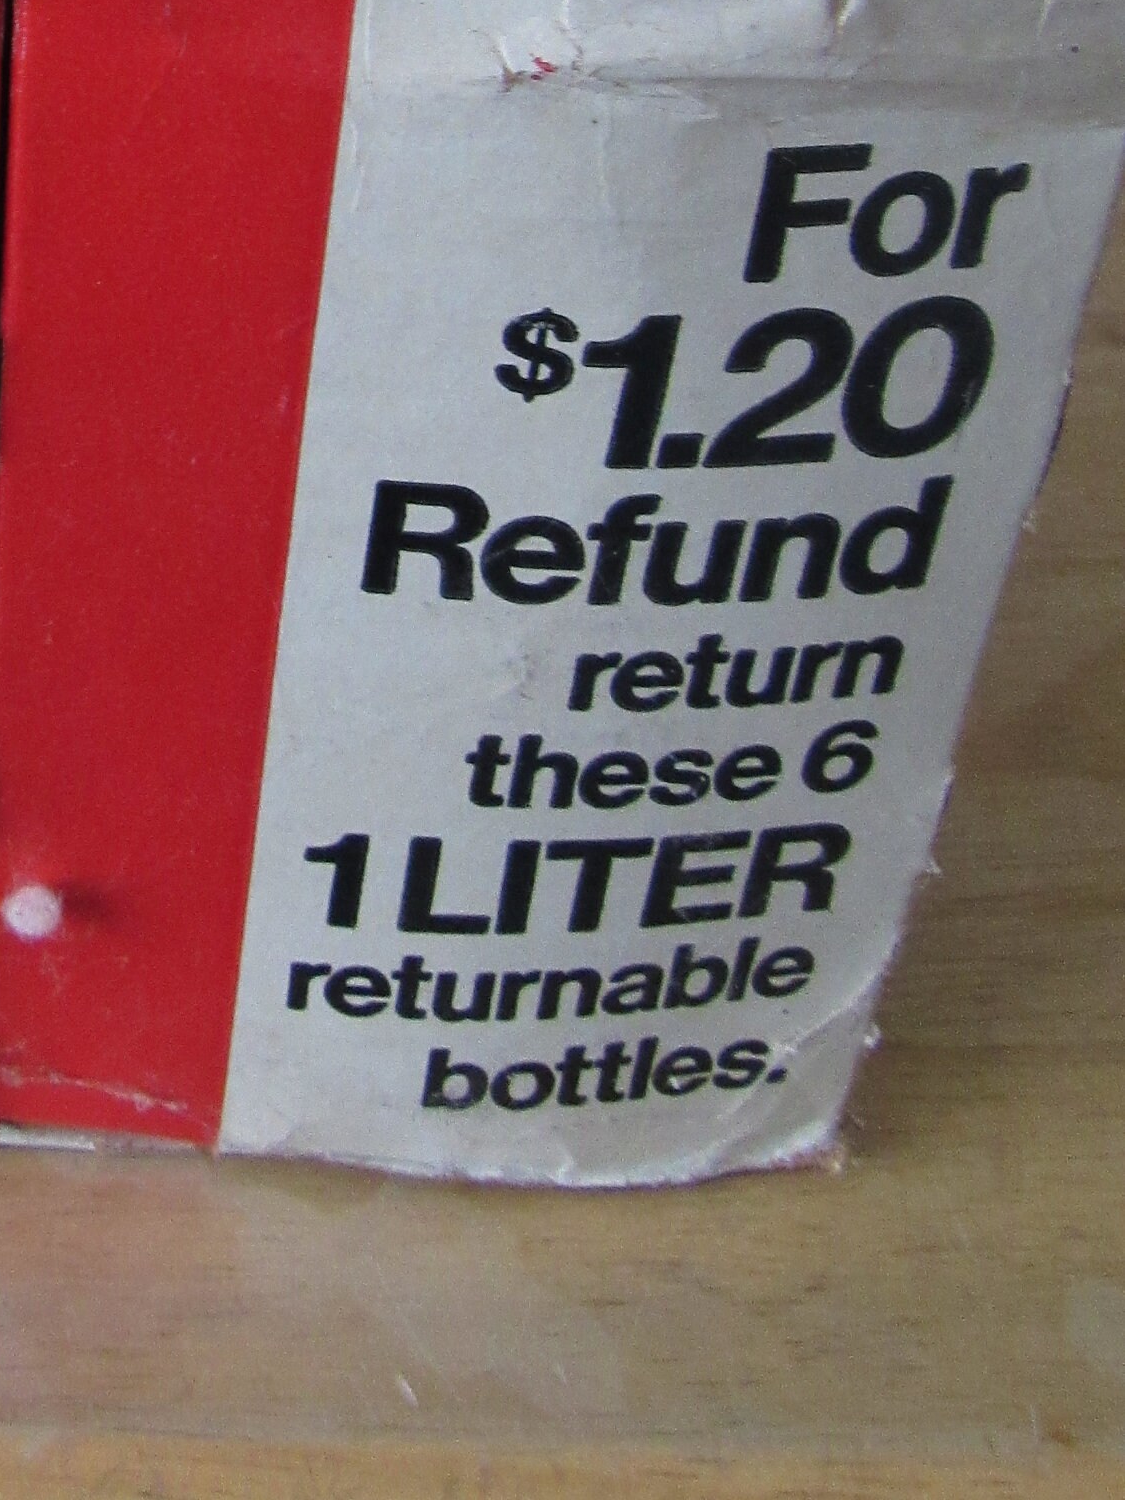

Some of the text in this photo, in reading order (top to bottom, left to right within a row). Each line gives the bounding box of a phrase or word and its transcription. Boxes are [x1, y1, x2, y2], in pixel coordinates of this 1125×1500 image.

[744, 144, 1029, 283] For
[361, 475, 954, 605] Refund
[568, 634, 905, 712] return
[465, 720, 879, 809] these 6
[304, 822, 852, 935] 1 LITER
[286, 937, 815, 1020] returnable
[421, 1037, 788, 1110] bottles.
